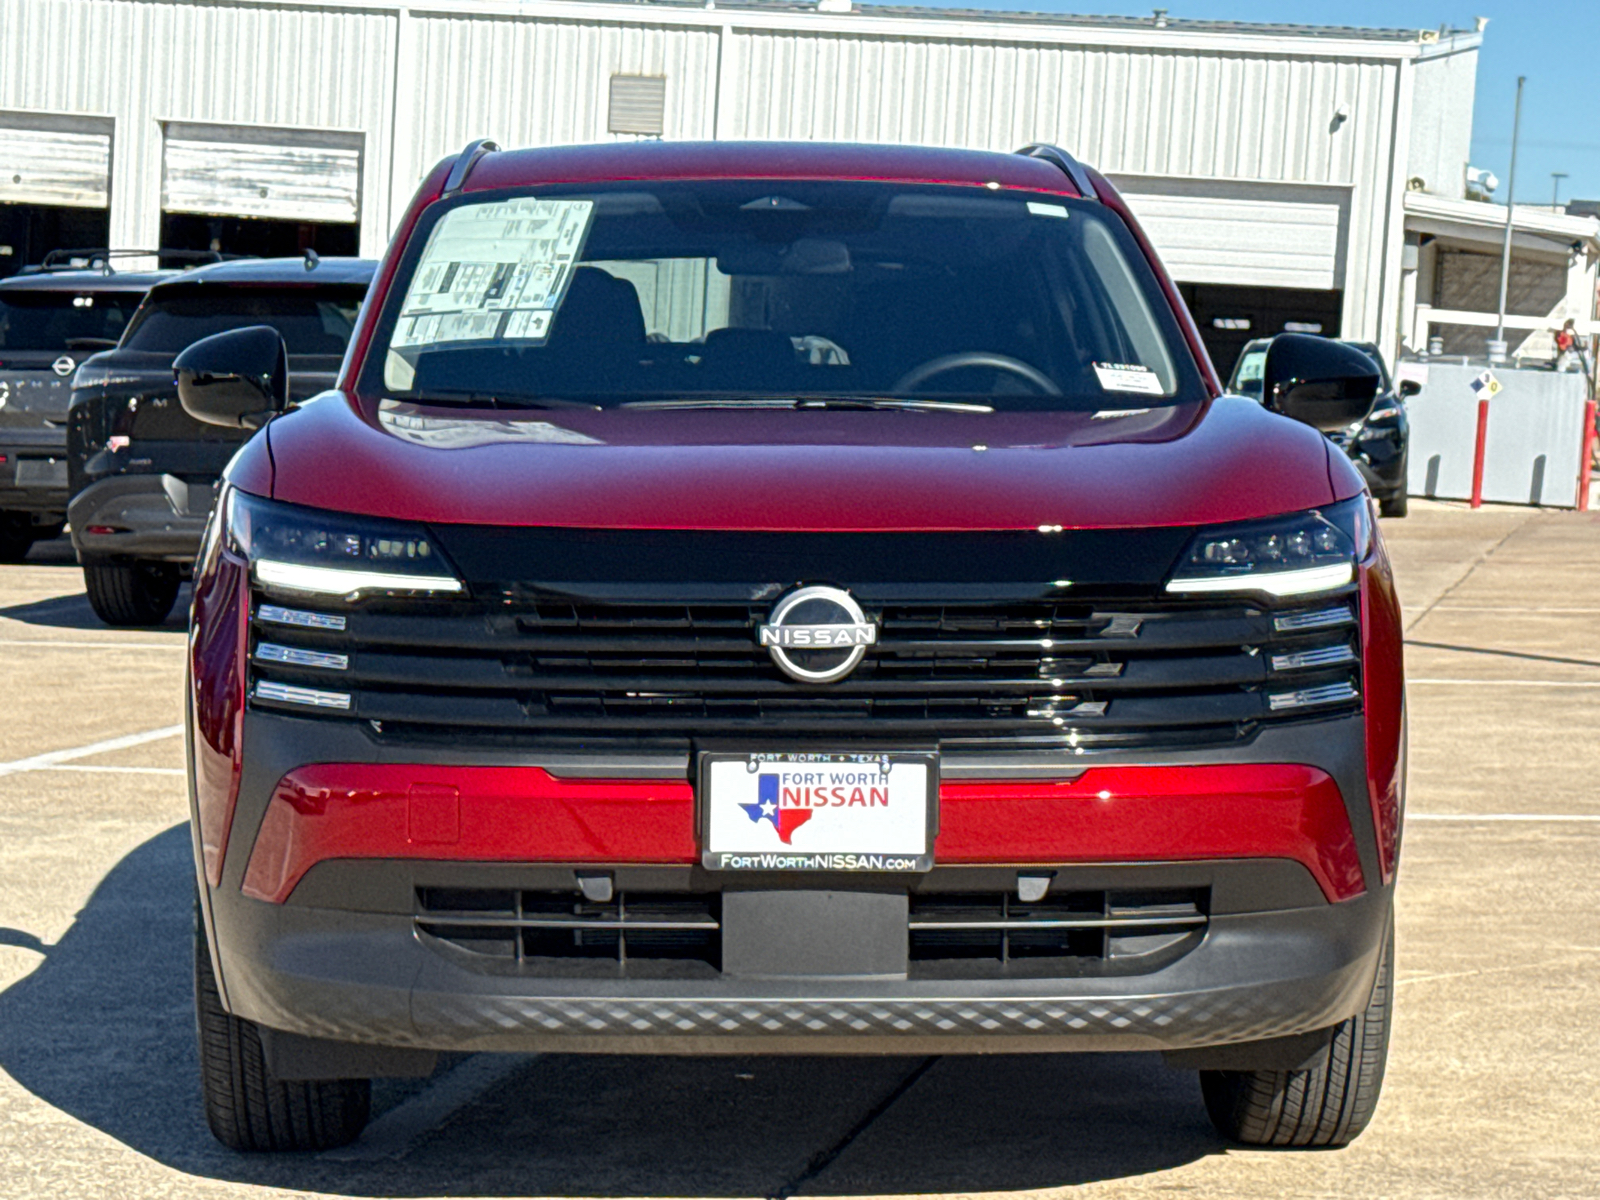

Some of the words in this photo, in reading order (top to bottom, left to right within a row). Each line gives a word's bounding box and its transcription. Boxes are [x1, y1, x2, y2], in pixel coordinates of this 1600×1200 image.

[762, 628, 873, 644] NISSAN
[750, 753, 781, 762] FORT
[788, 754, 831, 762] WORTH
[850, 754, 889, 763] TEXAS
[782, 773, 824, 785] FORT
[830, 773, 888, 785] WORTH
[782, 787, 888, 807] NISSAN
